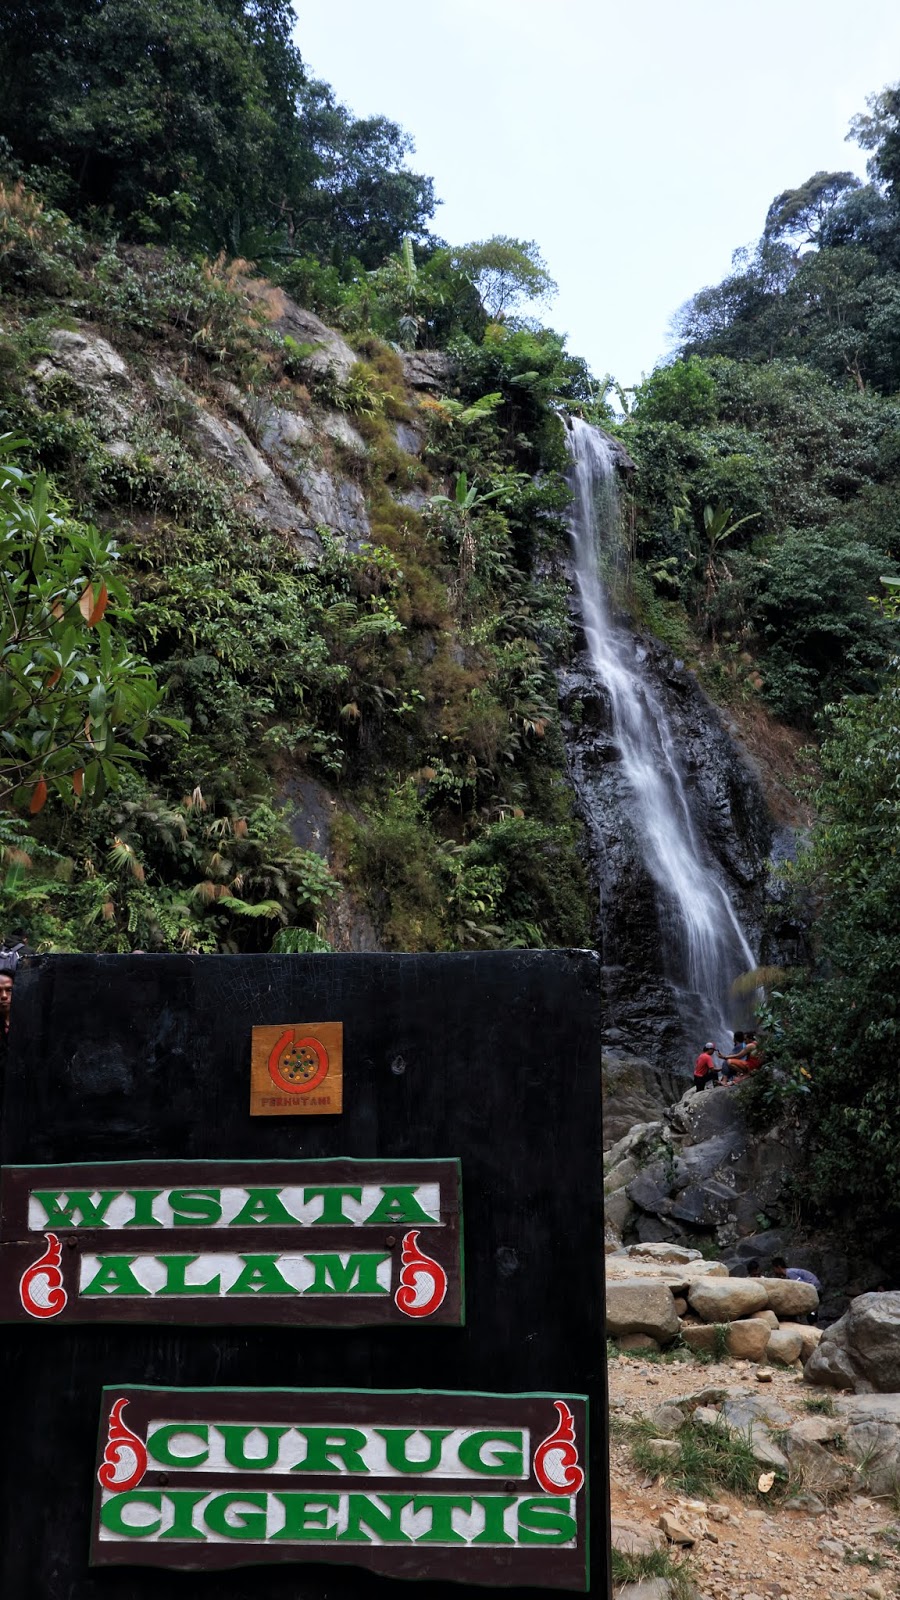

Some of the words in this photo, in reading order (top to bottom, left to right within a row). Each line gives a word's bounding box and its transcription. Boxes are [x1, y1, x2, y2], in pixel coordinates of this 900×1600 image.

[261, 1096, 331, 1107] PERHUTANI
[35, 1187, 437, 1227] WISATA
[84, 1254, 387, 1295] ALAM
[148, 1424, 524, 1475] CURUG
[101, 1491, 576, 1543] CIGENTIS
